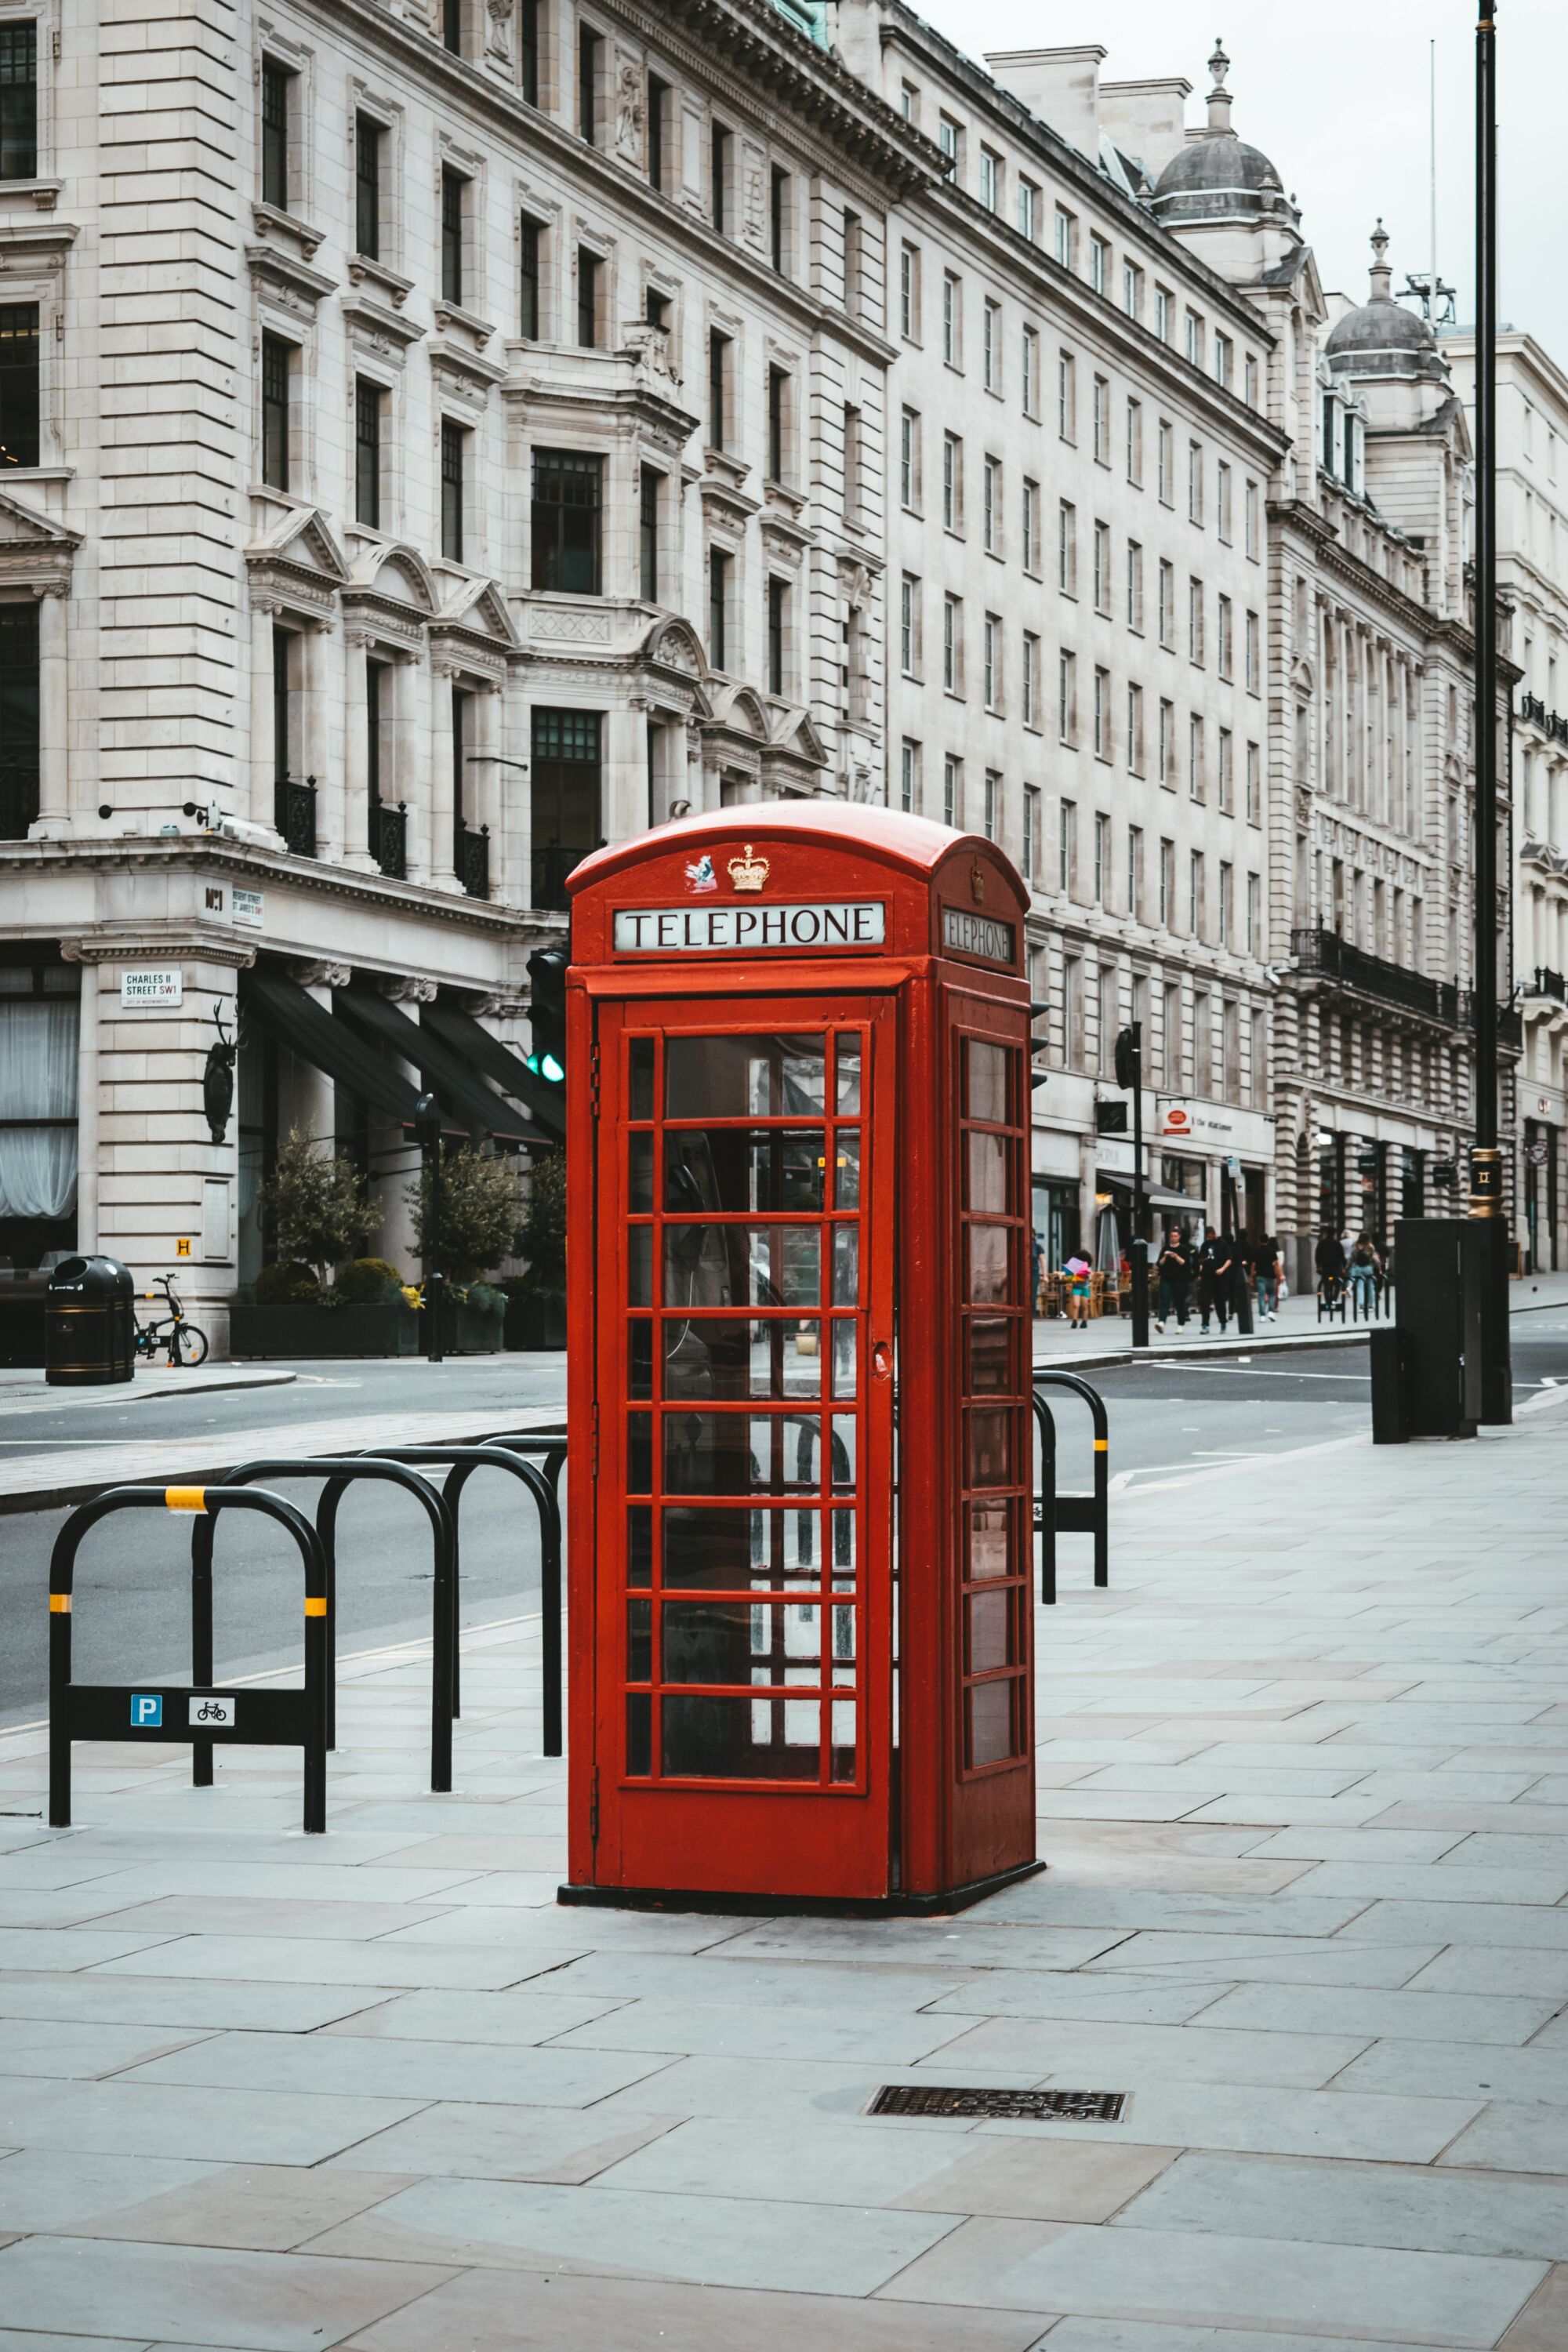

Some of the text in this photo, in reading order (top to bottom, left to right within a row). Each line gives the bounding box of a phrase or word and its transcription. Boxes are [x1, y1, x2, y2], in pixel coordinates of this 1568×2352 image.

[625, 907, 873, 948] TELEPHONE
[126, 975, 172, 985] CHARLES II
[126, 985, 177, 996] STREET SW1
[178, 1240, 189, 1254] H
[139, 1698, 157, 1723] P
